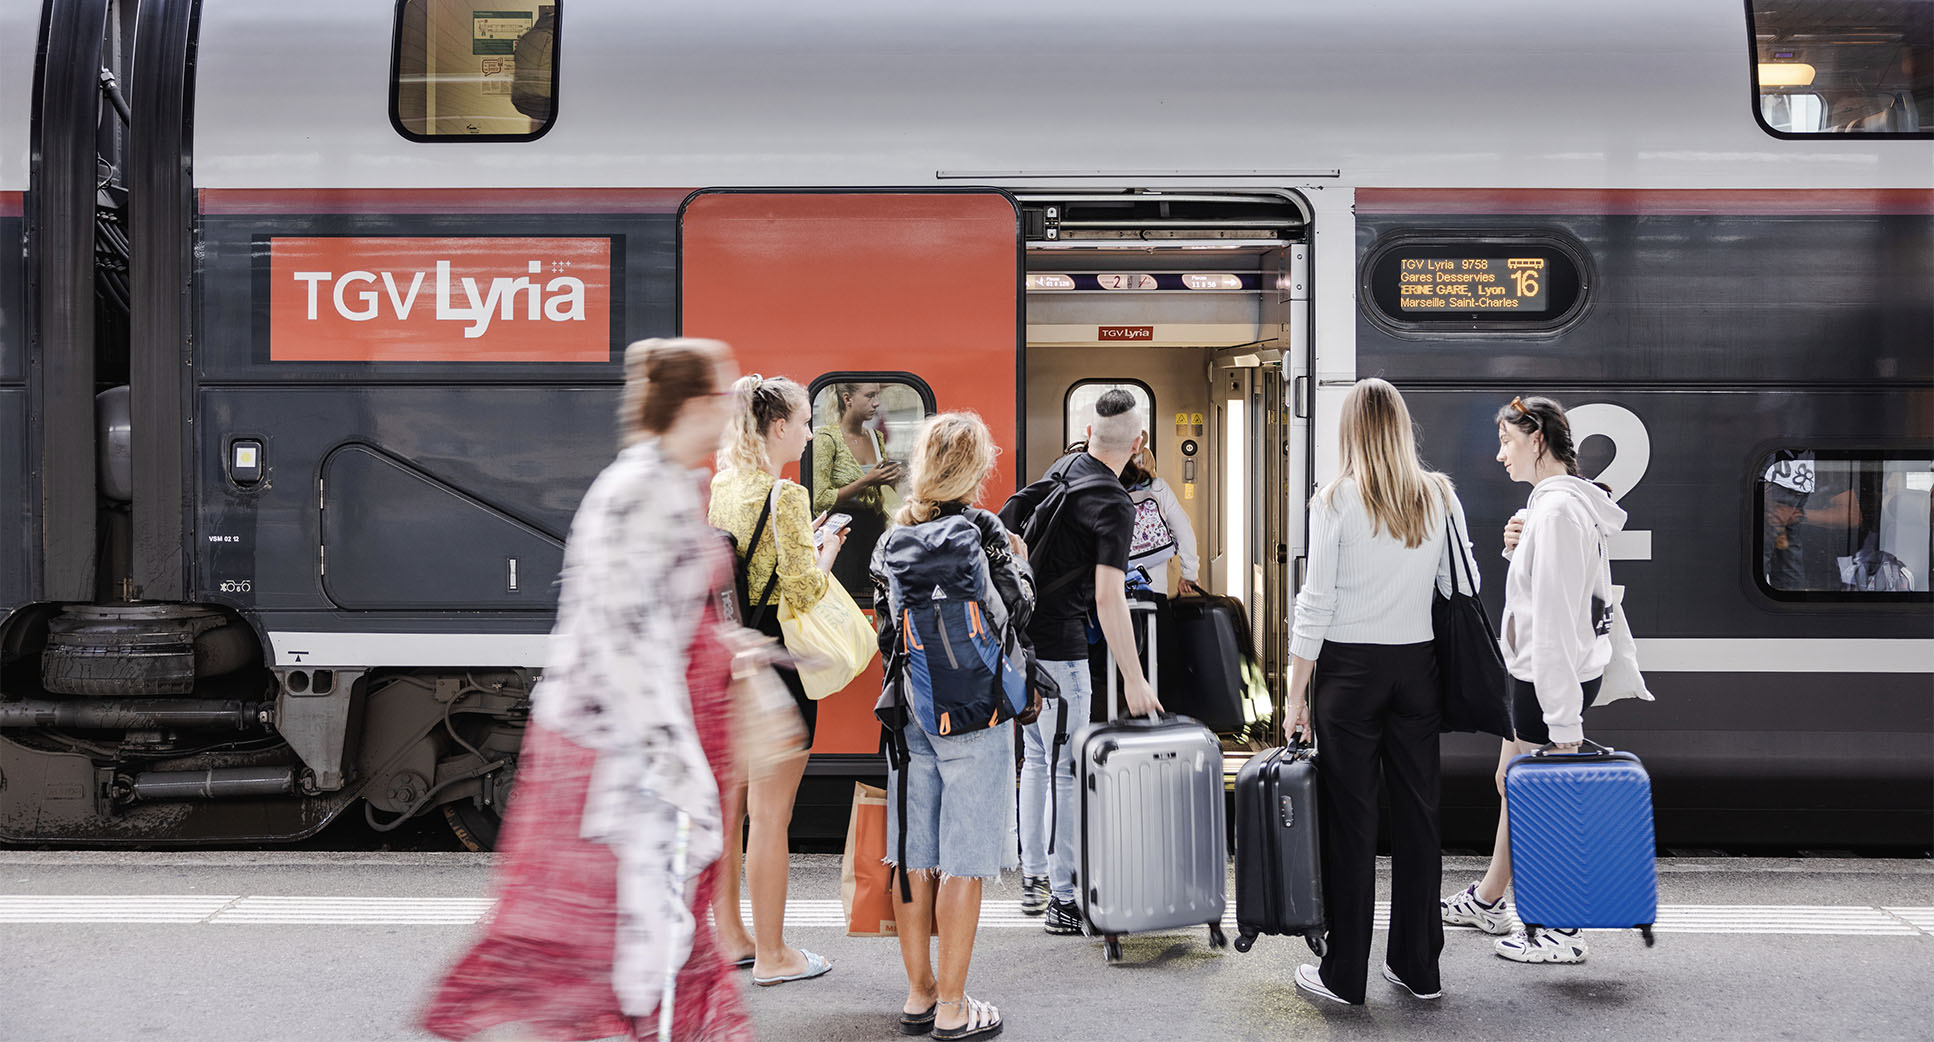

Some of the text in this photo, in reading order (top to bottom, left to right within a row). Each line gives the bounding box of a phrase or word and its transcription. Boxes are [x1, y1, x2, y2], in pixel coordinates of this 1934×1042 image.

[1401, 259, 1489, 271] TGV Lyria 9758
[1113, 275, 1121, 289] 2
[1400, 272, 1496, 283] Gares Desservies
[1510, 270, 1539, 297] 16
[1478, 285, 1506, 297] Lyon
[294, 260, 586, 339] TGV Lyria
[1400, 297, 1519, 308] Marseille Saint-Charles
[1102, 328, 1150, 339] TGV Lyria
